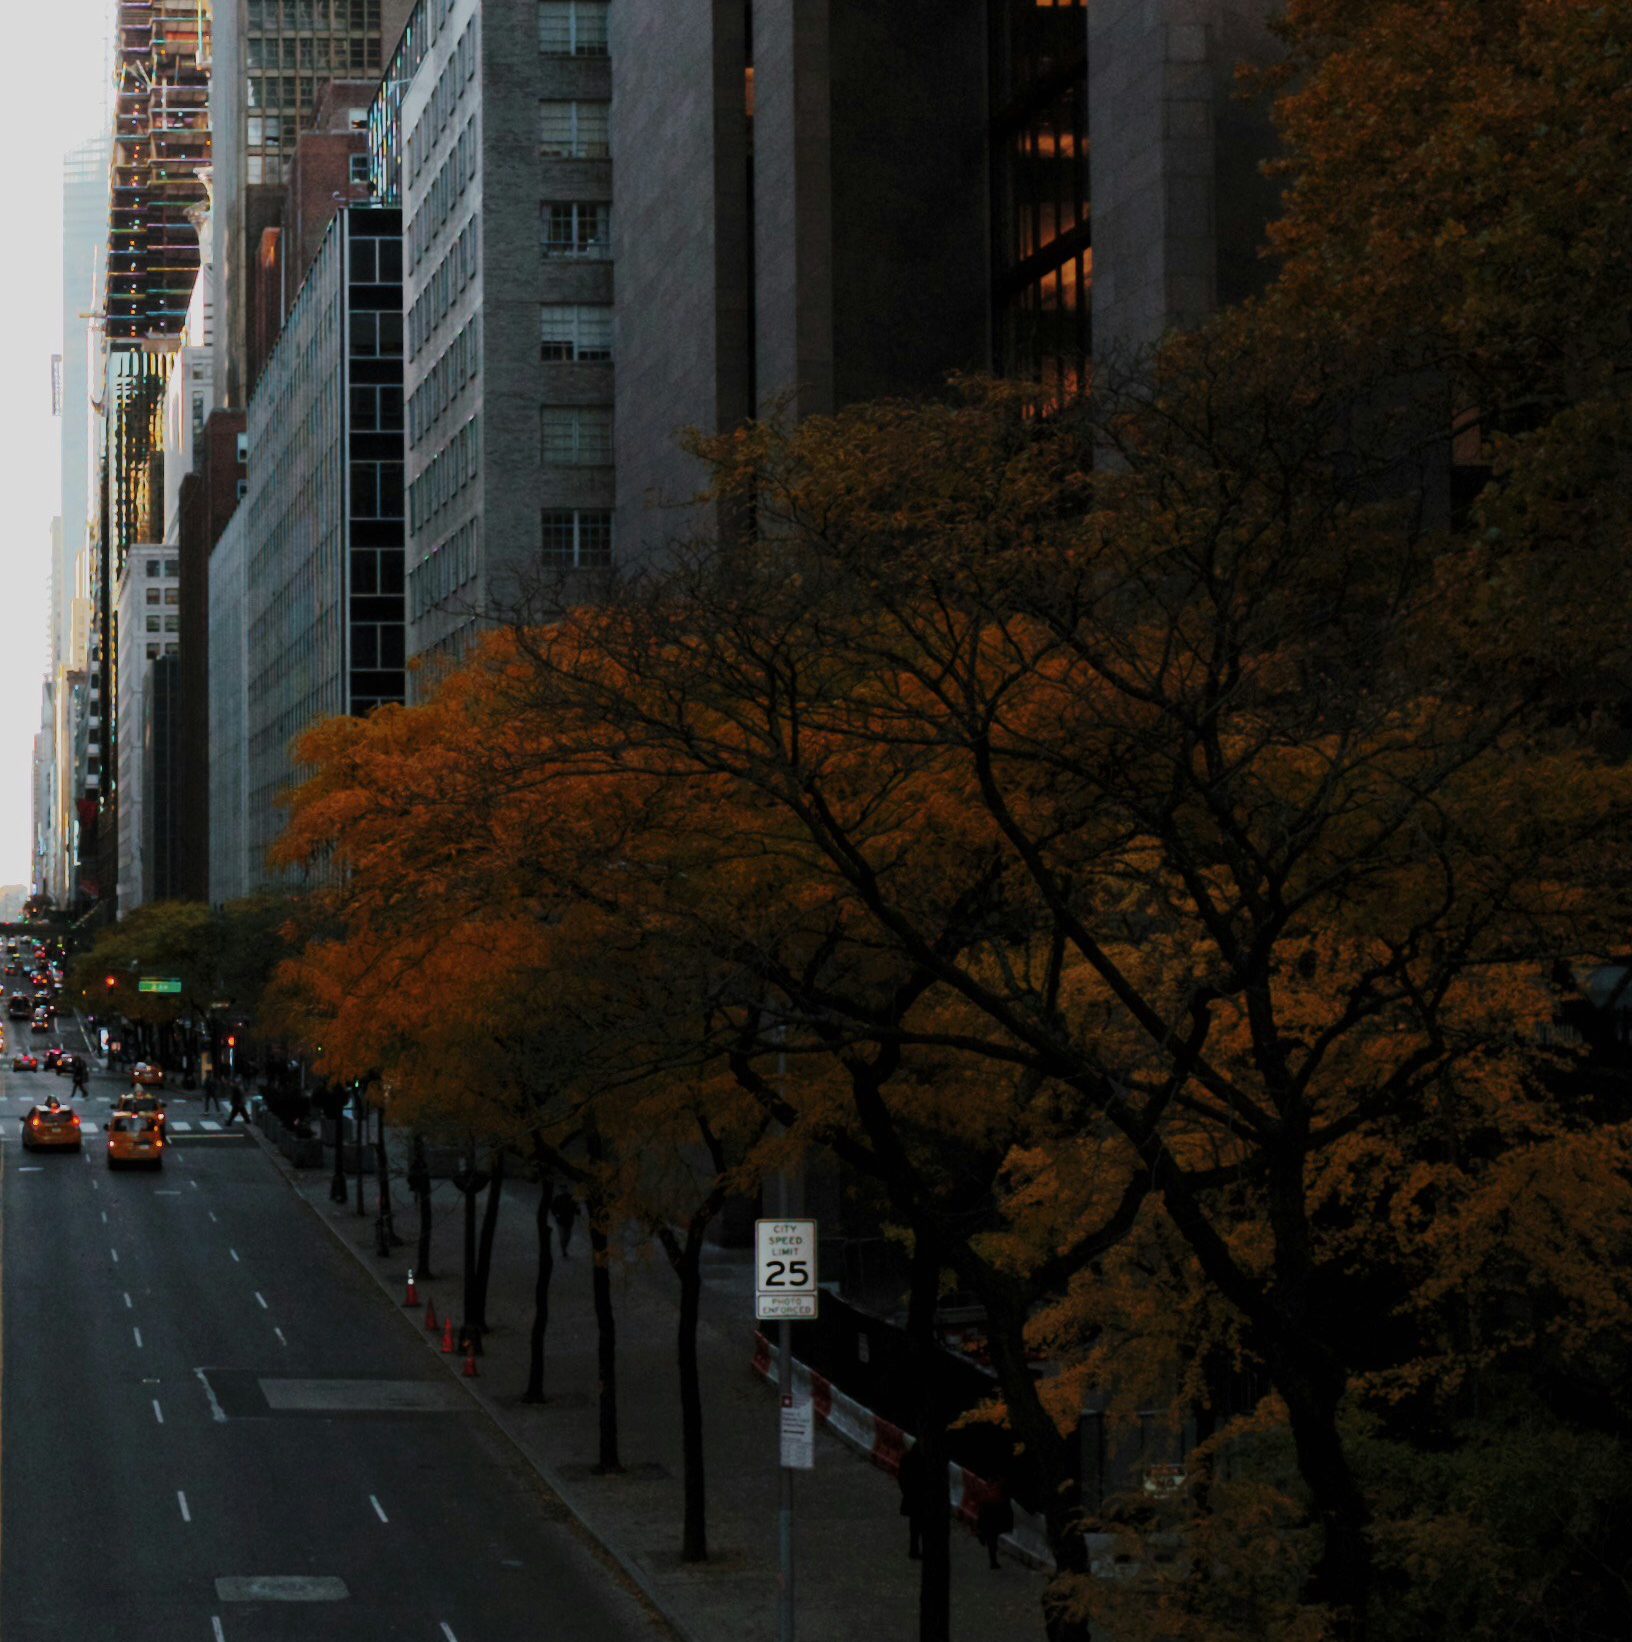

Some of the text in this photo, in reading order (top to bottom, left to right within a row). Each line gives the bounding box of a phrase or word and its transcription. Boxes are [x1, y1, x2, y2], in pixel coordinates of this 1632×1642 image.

[773, 1225, 797, 1233] CITY
[768, 1237, 803, 1245] SPEED
[772, 1247, 799, 1255] LIMIT
[766, 1261, 808, 1286] 25
